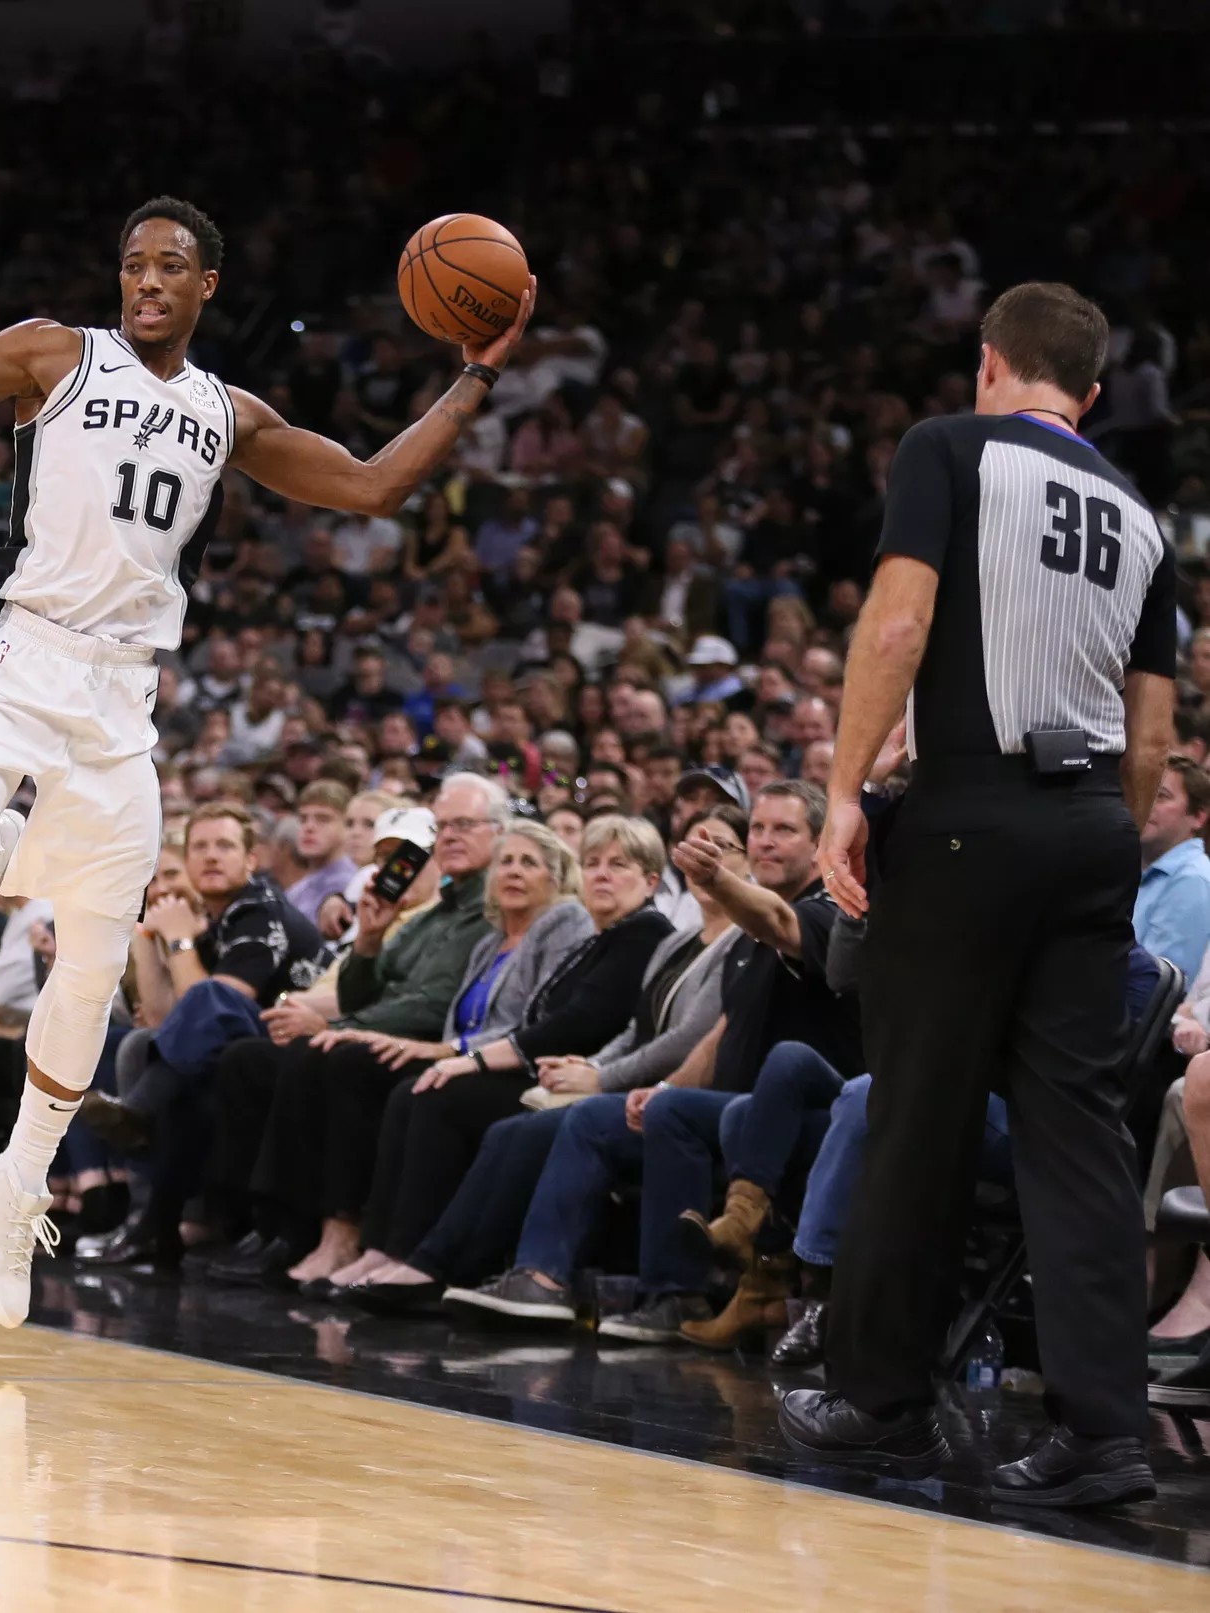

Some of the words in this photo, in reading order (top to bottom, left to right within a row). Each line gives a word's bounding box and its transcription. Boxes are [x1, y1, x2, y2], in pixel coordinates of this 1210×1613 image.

[82, 398, 221, 466] SPURS
[189, 390, 219, 410] Frost
[110, 459, 185, 535] 10
[1040, 480, 1122, 591] 36
